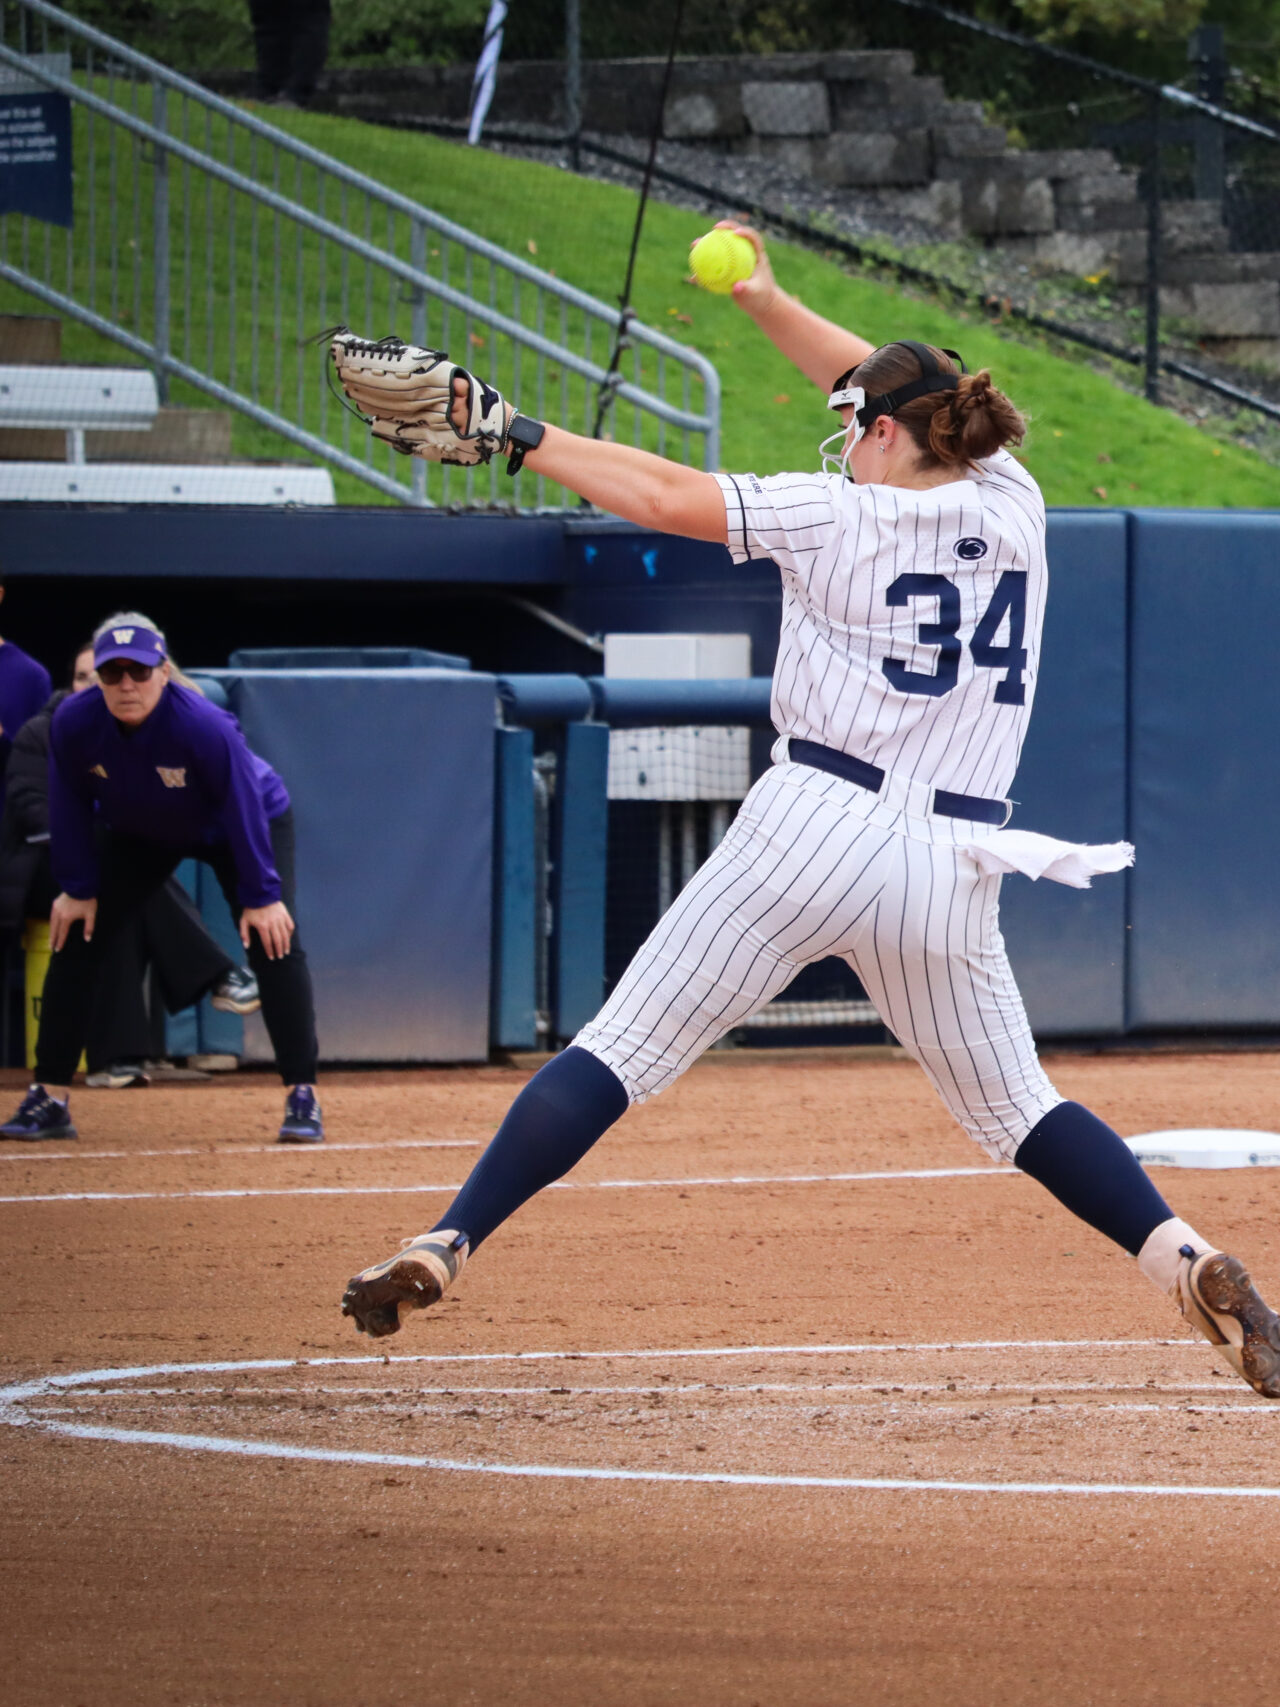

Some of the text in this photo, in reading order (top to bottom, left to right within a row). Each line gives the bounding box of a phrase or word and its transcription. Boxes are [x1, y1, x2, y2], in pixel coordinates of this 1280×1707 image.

[752, 482, 763, 495] ARE
[112, 628, 135, 644] W
[882, 570, 1028, 706] 34
[156, 766, 187, 788] W
